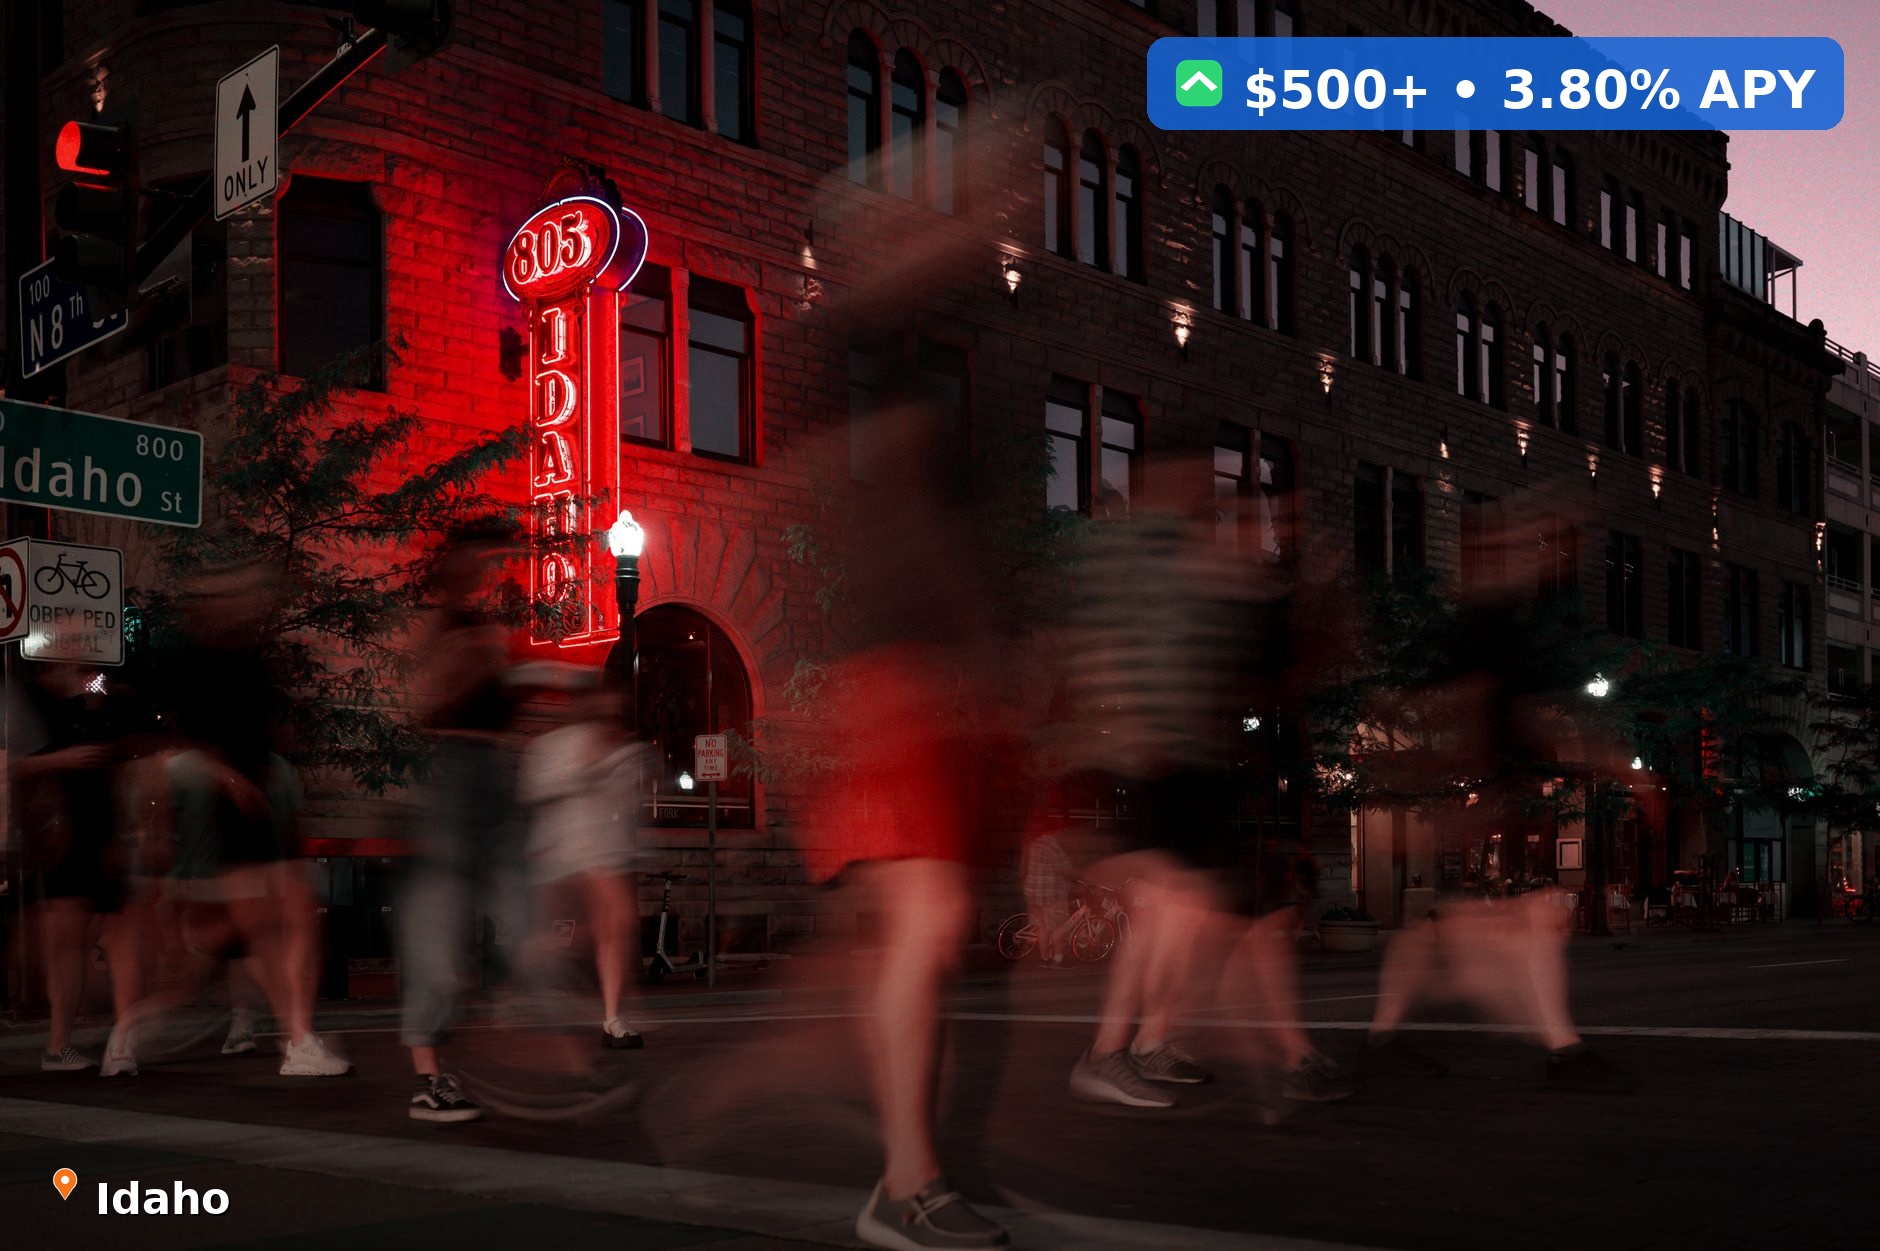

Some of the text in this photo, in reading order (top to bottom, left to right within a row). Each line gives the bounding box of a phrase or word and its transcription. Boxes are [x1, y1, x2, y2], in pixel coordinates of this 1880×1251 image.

[224, 155, 268, 202] ONLY
[512, 210, 590, 285] 805
[29, 274, 51, 306] 100
[30, 312, 45, 362] N
[136, 434, 184, 462] 800
[533, 307, 577, 604] IDAHO
[160, 490, 183, 514] St
[29, 604, 116, 629] OBEY PED
[43, 632, 104, 654] SIGNAL
[697, 749, 725, 758] PARKING
[704, 739, 717, 748] NO
[704, 764, 718, 772] TIME
